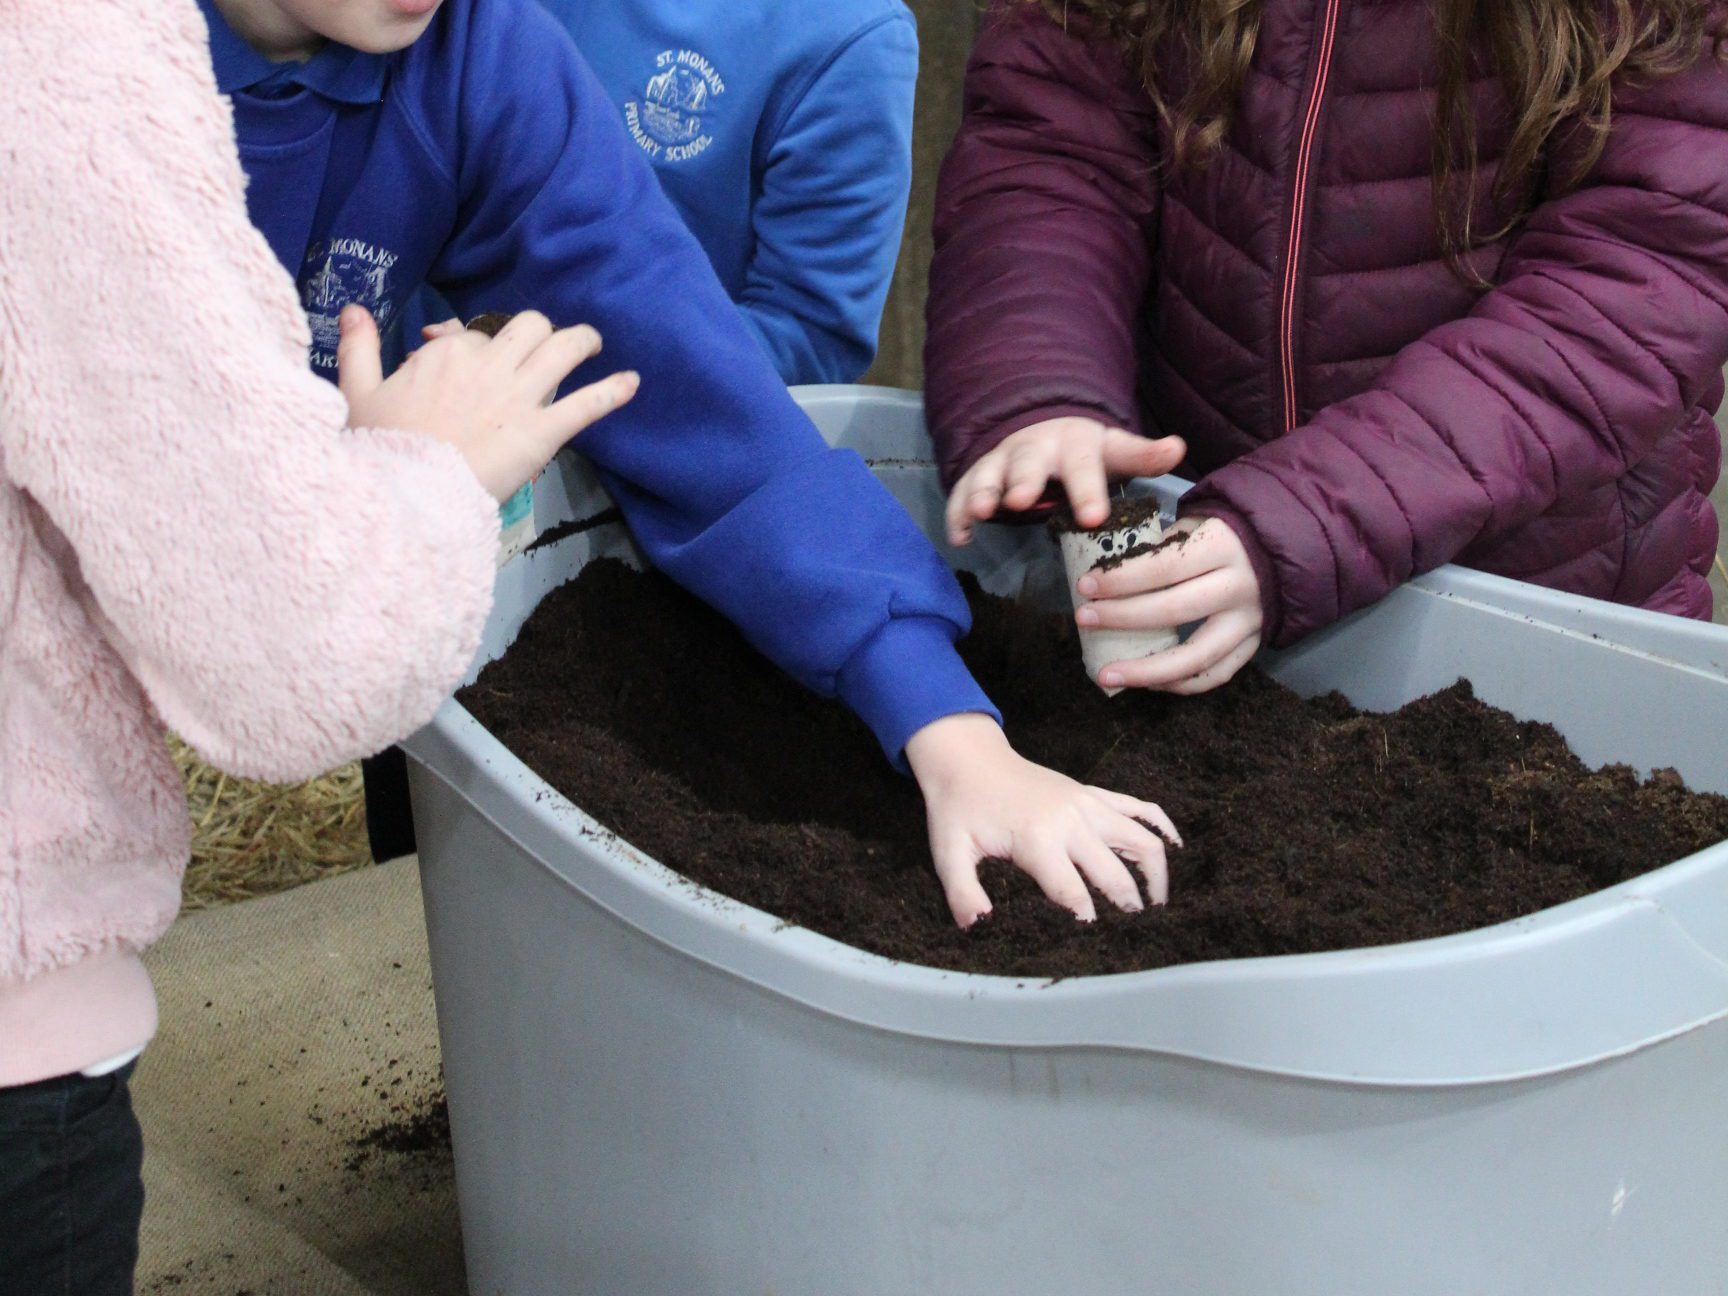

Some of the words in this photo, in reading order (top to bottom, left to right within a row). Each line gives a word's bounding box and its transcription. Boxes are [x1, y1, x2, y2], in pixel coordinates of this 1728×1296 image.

[676, 49, 725, 96] MONANS
[624, 101, 662, 157] PRIMARY
[664, 134, 713, 162] SCHOOL
[328, 237, 399, 269] MONANS
